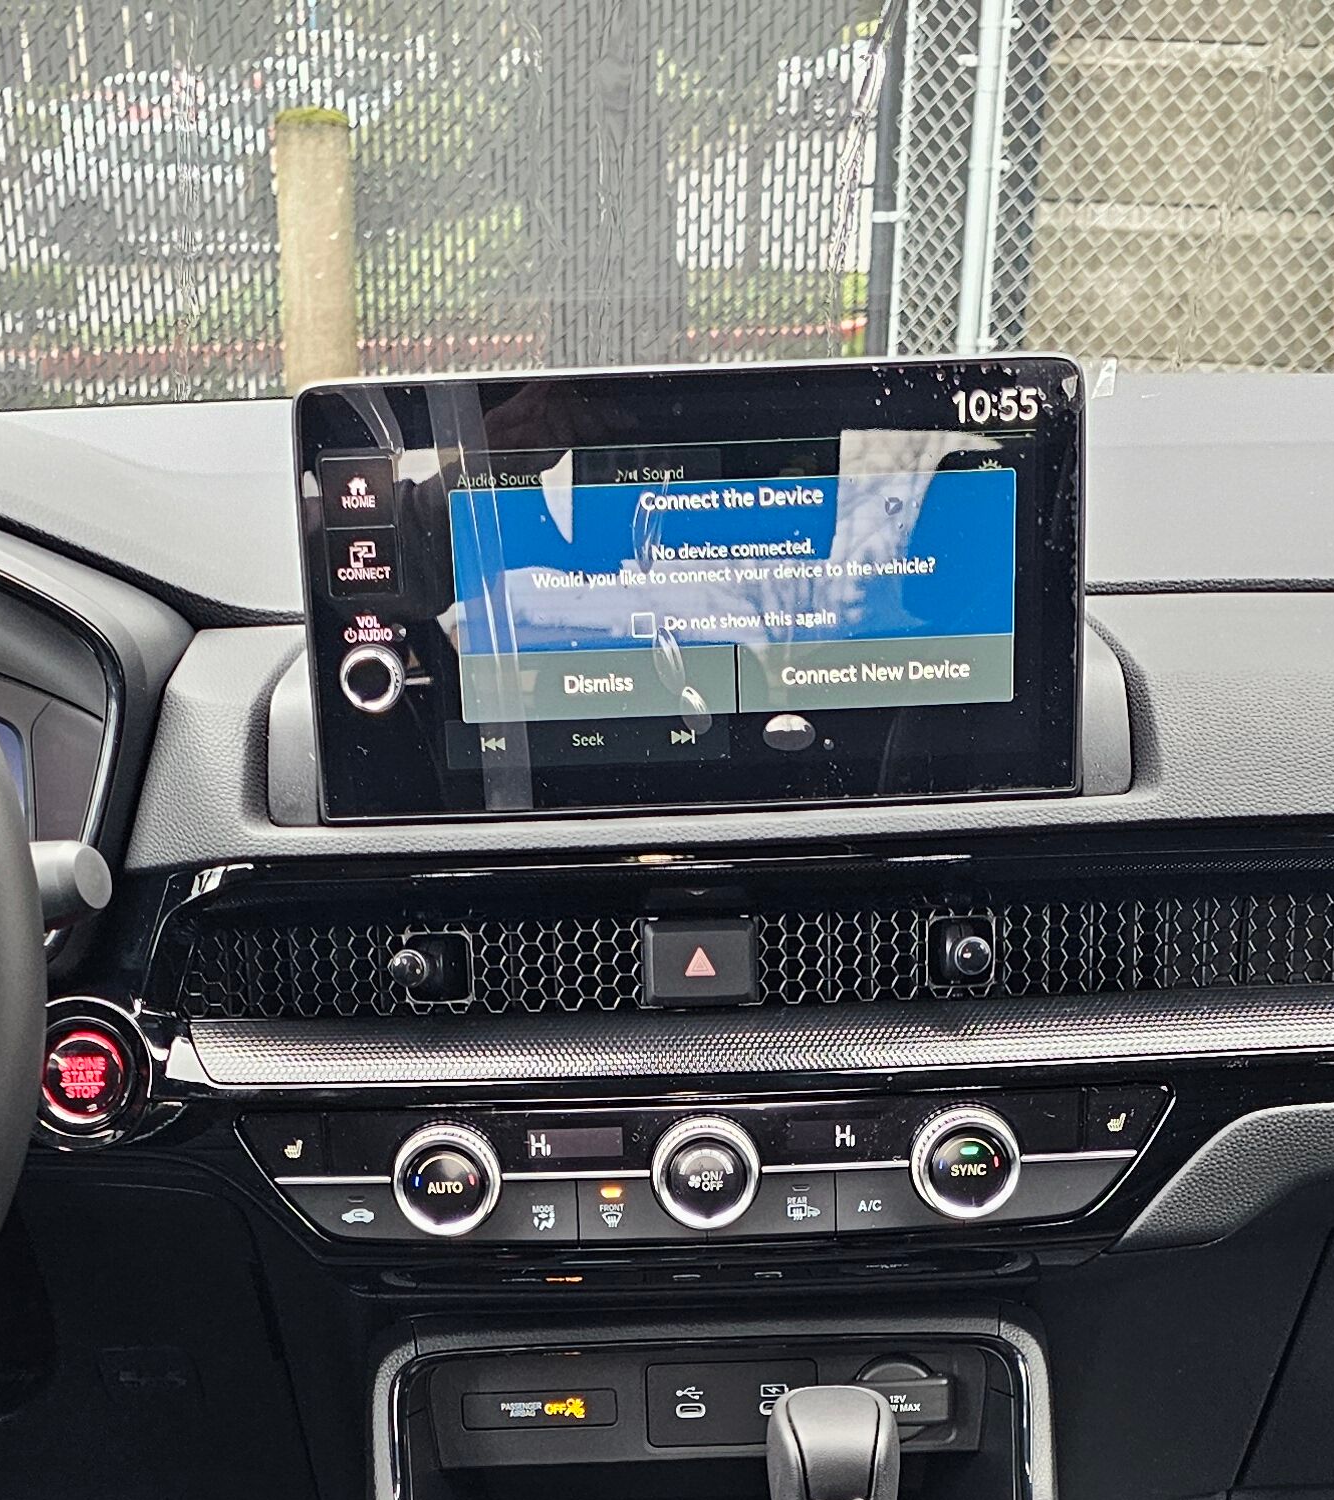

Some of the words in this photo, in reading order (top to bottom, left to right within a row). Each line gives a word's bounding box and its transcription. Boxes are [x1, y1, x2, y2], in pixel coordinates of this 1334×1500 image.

[952, 387, 1040, 424] 10:55
[457, 472, 496, 488] Audio
[642, 466, 684, 482] Sound
[341, 495, 376, 509] HOME
[640, 488, 720, 511] Connect
[724, 486, 755, 508] the
[758, 485, 825, 508] Device
[652, 544, 675, 561] No
[678, 541, 729, 560] device
[731, 538, 815, 558] connected.
[337, 566, 391, 581] CONNECT
[532, 572, 584, 589] Would
[587, 574, 616, 593] you
[619, 570, 646, 587] like
[649, 569, 666, 585] to
[670, 566, 730, 584] connect
[734, 563, 770, 585] your
[773, 563, 823, 580] device
[826, 562, 844, 577] to
[847, 560, 872, 577] the
[876, 556, 936, 576] vehicle?
[355, 616, 381, 629] VOL
[664, 616, 687, 632] Do
[691, 613, 717, 630] not
[720, 611, 761, 628] show
[764, 610, 793, 627] this
[795, 609, 837, 630] again
[358, 628, 393, 642] AUDIO
[781, 664, 857, 686] Connect
[861, 662, 903, 684] New
[904, 659, 970, 683] Device
[563, 672, 634, 695] Dismiss
[572, 730, 606, 749] Seek
[61, 1071, 103, 1084] START
[65, 1086, 101, 1099] STOP
[701, 1171, 724, 1183] ON/
[950, 1163, 988, 1178] SYNC
[426, 1181, 464, 1195] AUTO
[701, 1181, 724, 1192] OFF
[599, 1203, 625, 1213] FRONT
[787, 1196, 807, 1206] REAR
[857, 1199, 882, 1213] A/C
[532, 1205, 555, 1213] MODE
[889, 1394, 907, 1404] 12V
[544, 1403, 566, 1415] OFF
[899, 1403, 921, 1413] MAX
